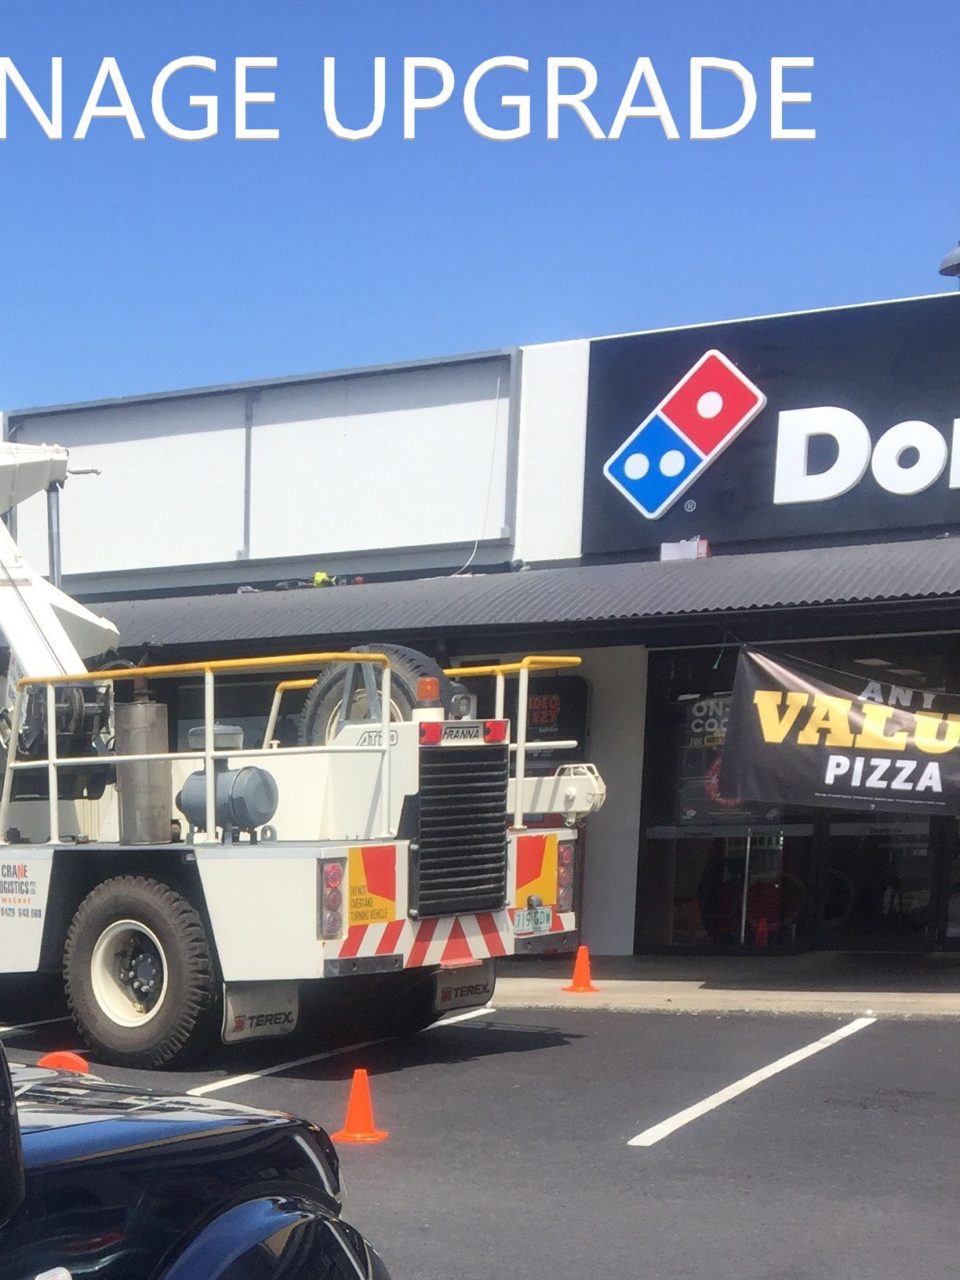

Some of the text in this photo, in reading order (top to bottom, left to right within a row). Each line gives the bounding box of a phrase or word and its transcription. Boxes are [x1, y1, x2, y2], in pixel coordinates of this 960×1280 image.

[773, 405, 960, 505] Do
[858, 680, 940, 709] ANY
[442, 726, 481, 740] FRANNA
[824, 755, 943, 793] PIZZA
[1, 863, 28, 879] CRANE
[453, 983, 490, 999] TEREX
[248, 1010, 294, 1028] TEREX
